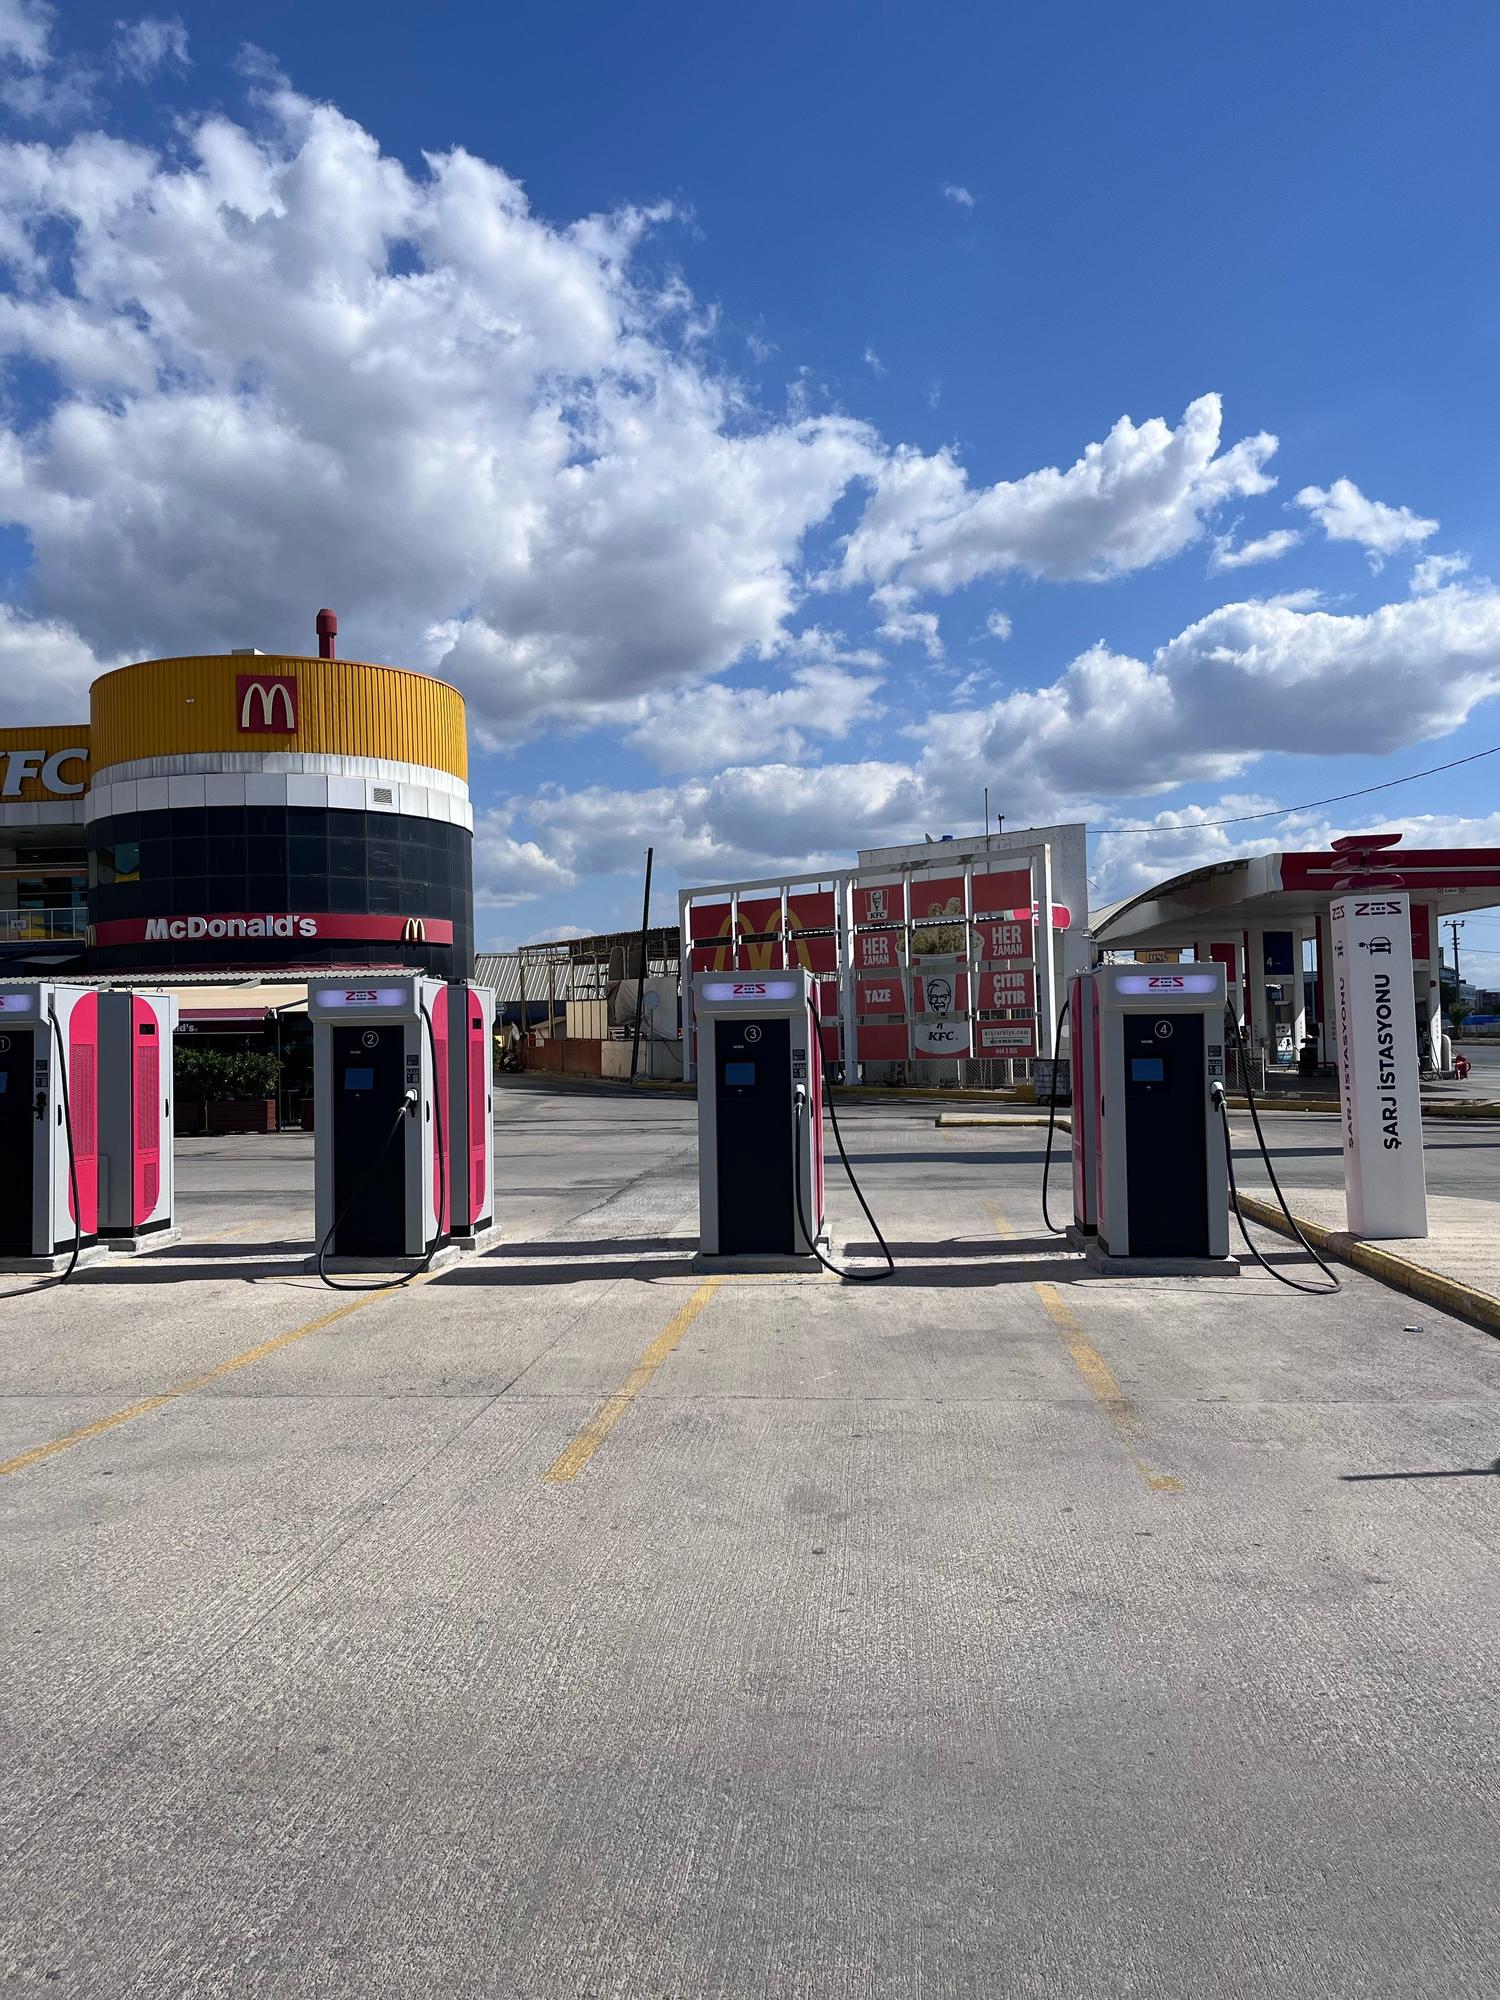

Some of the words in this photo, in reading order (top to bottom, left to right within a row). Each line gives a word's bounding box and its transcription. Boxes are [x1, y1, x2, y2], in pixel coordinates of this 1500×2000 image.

[0, 748, 88, 796] FC
[870, 911, 885, 919] KFC
[1355, 901, 1402, 916] ZES
[145, 915, 317, 940] McDonald's
[991, 925, 1022, 945] HER
[862, 936, 889, 955] HER
[992, 943, 1023, 956] ZAMAN
[863, 954, 889, 965] ZAMAN
[992, 973, 1025, 990] ÇITIR
[1149, 976, 1184, 987] ZES
[346, 990, 378, 1000] ZES
[733, 984, 766, 994] ZES
[865, 988, 892, 1003] TAZE
[993, 990, 1026, 1008] ÇITIR
[749, 1028, 757, 1039] 3
[928, 1031, 955, 1042] KFC
[1160, 1024, 1168, 1035] 4
[1374, 974, 1396, 1090] İSTASYONU
[366, 1034, 375, 1045] 2
[1381, 1096, 1402, 1150] ŞARJ
